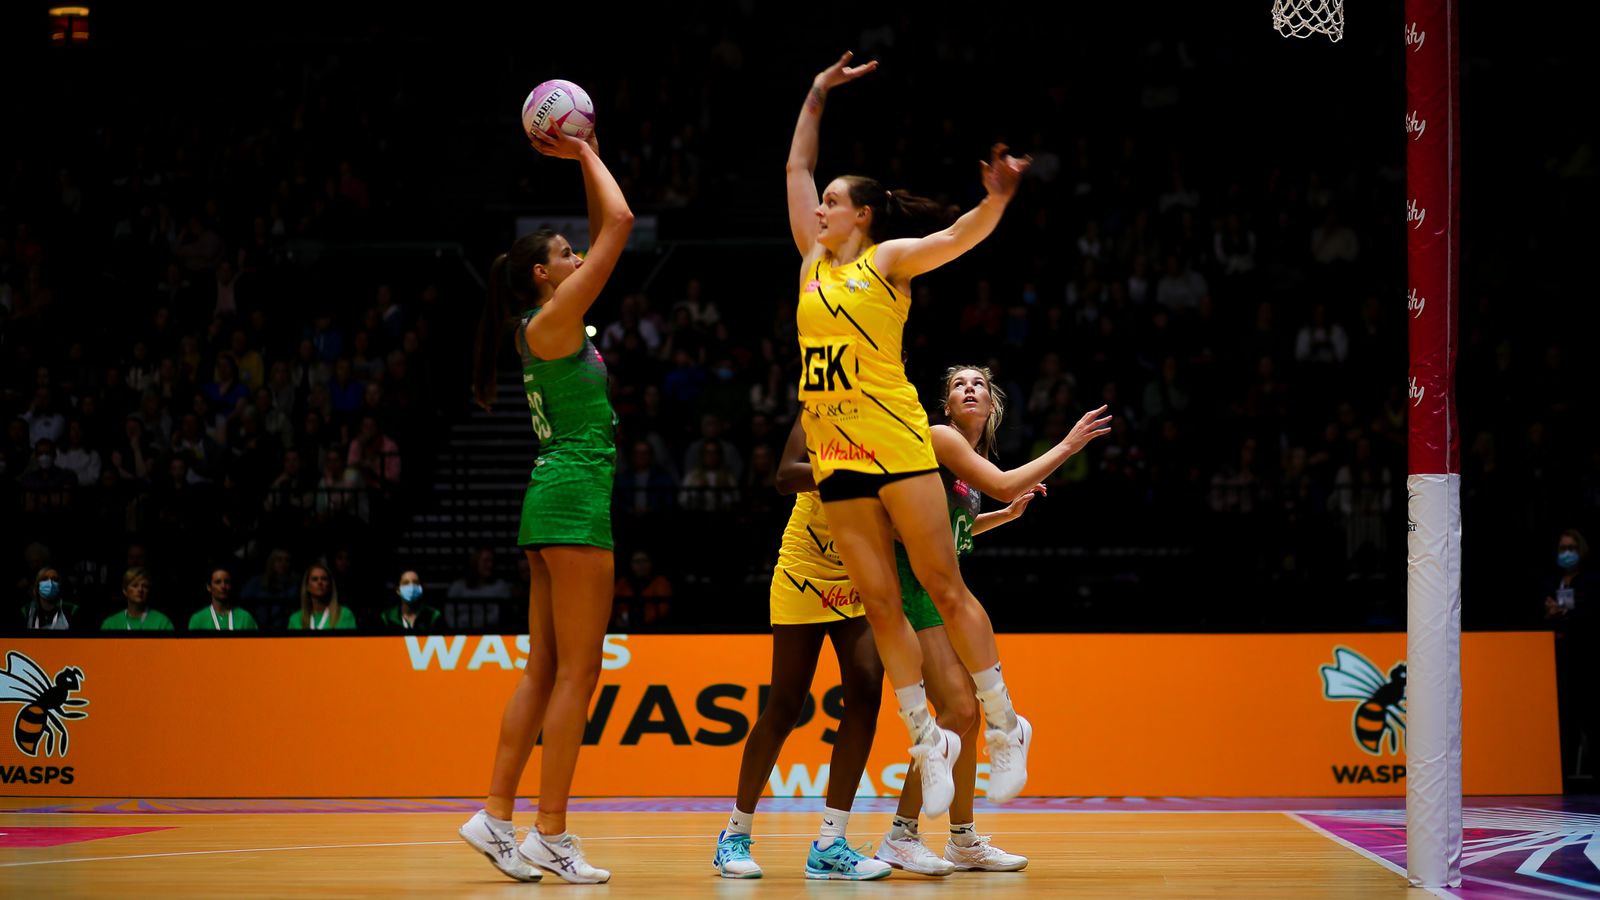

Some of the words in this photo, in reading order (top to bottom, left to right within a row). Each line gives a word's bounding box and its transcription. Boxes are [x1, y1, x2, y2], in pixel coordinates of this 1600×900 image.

[803, 344, 852, 392] GK
[820, 438, 876, 466] Vitality
[821, 584, 861, 609] Vitali
[404, 635, 631, 670] WAS
[1331, 765, 1407, 784] WASP
